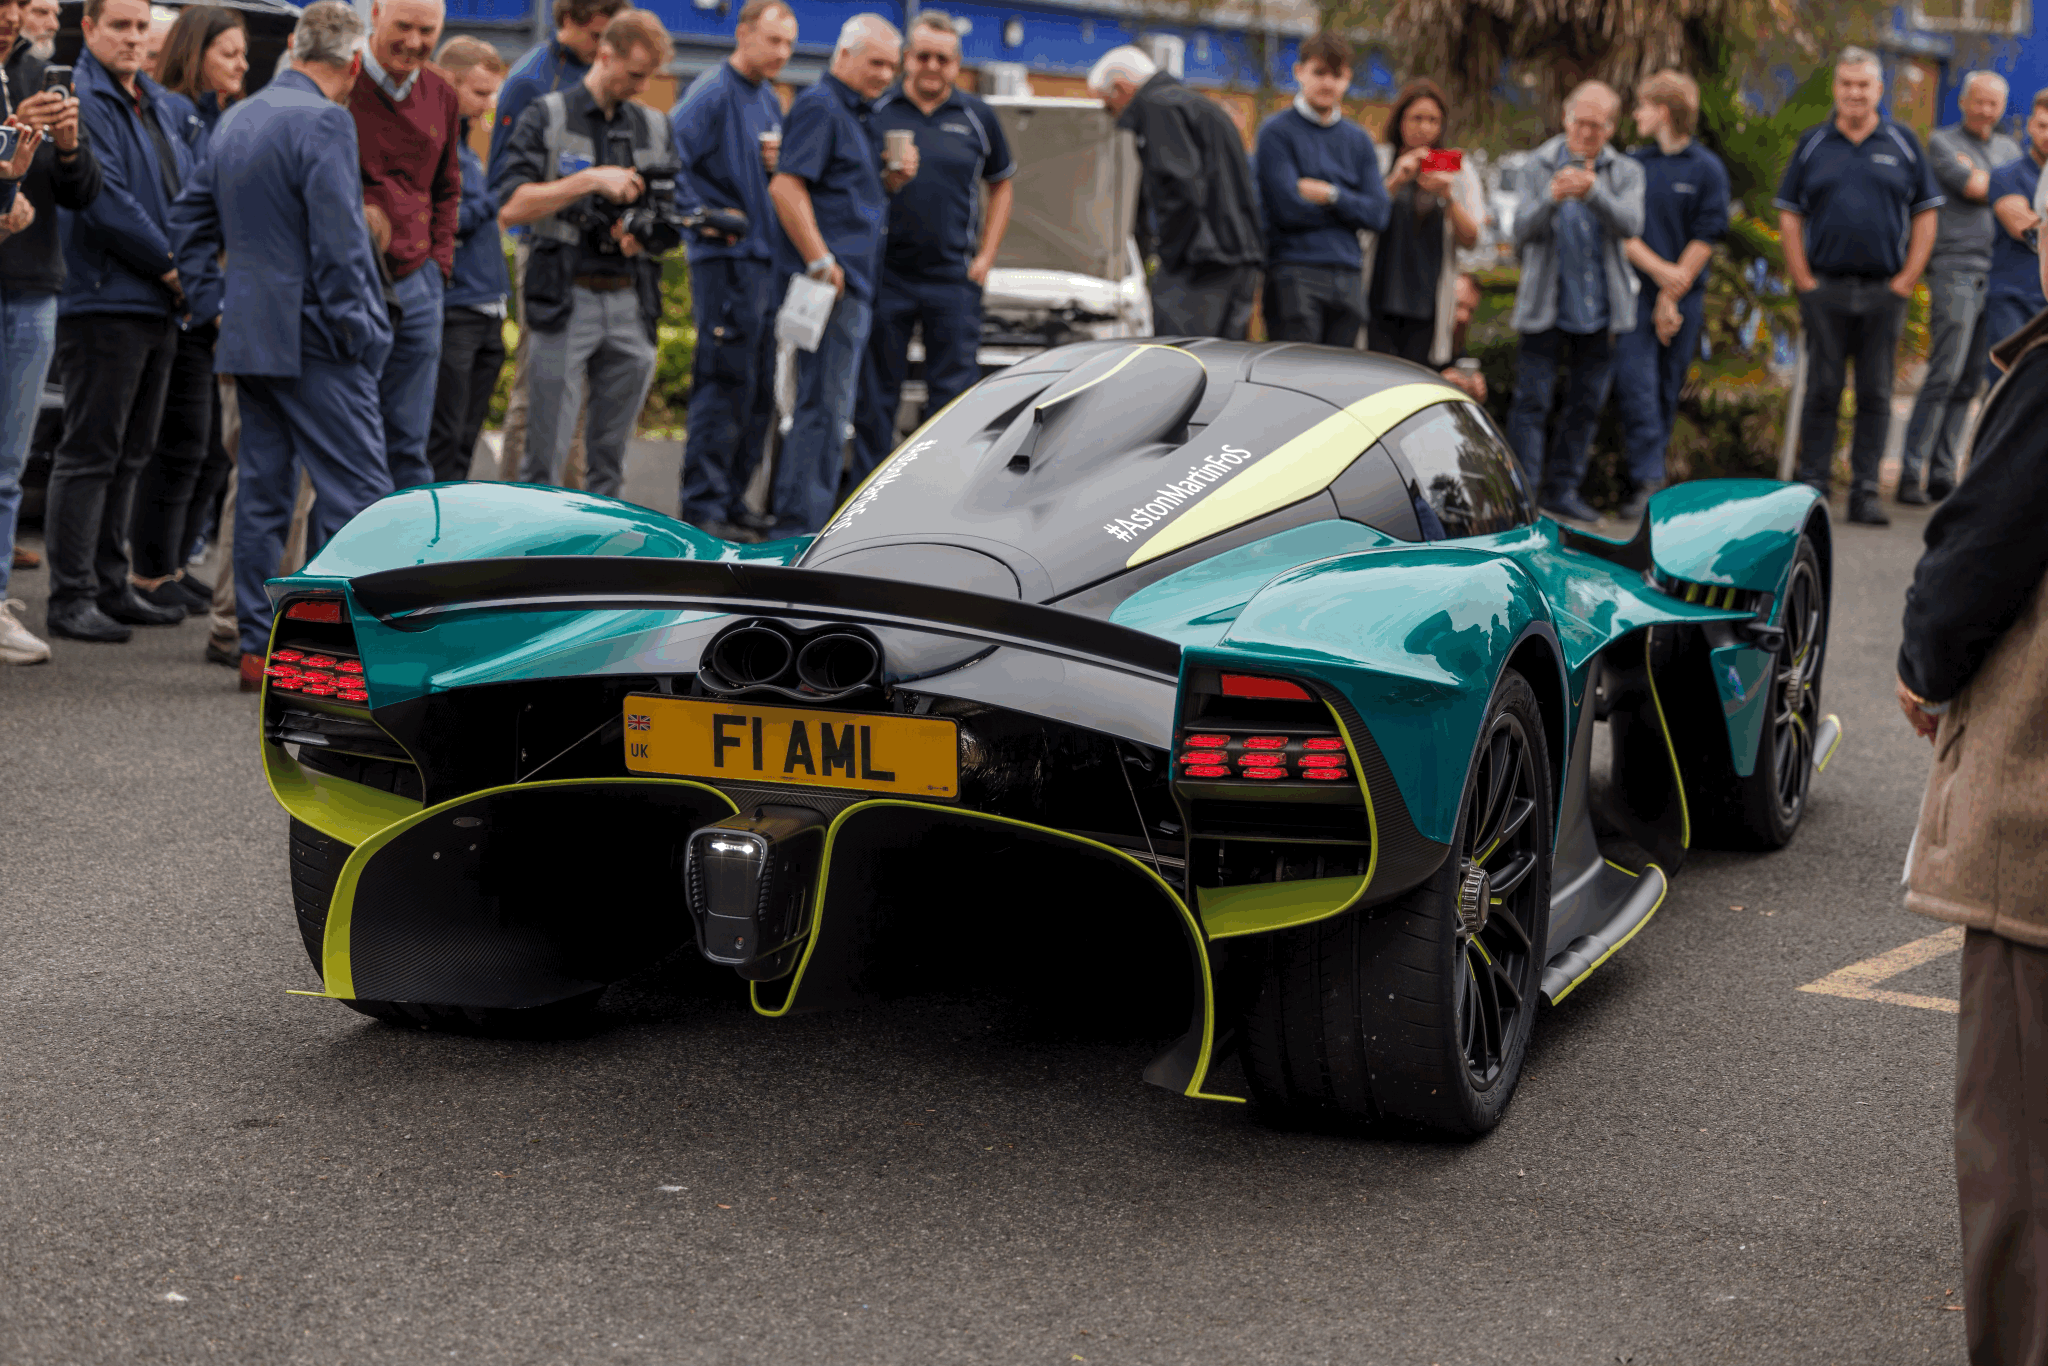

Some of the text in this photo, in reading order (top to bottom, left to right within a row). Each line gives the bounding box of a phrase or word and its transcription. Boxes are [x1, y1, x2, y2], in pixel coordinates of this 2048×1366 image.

[1103, 444, 1252, 543] #AstonMartinFoS
[631, 743, 649, 759] UK
[783, 719, 896, 782] AML
